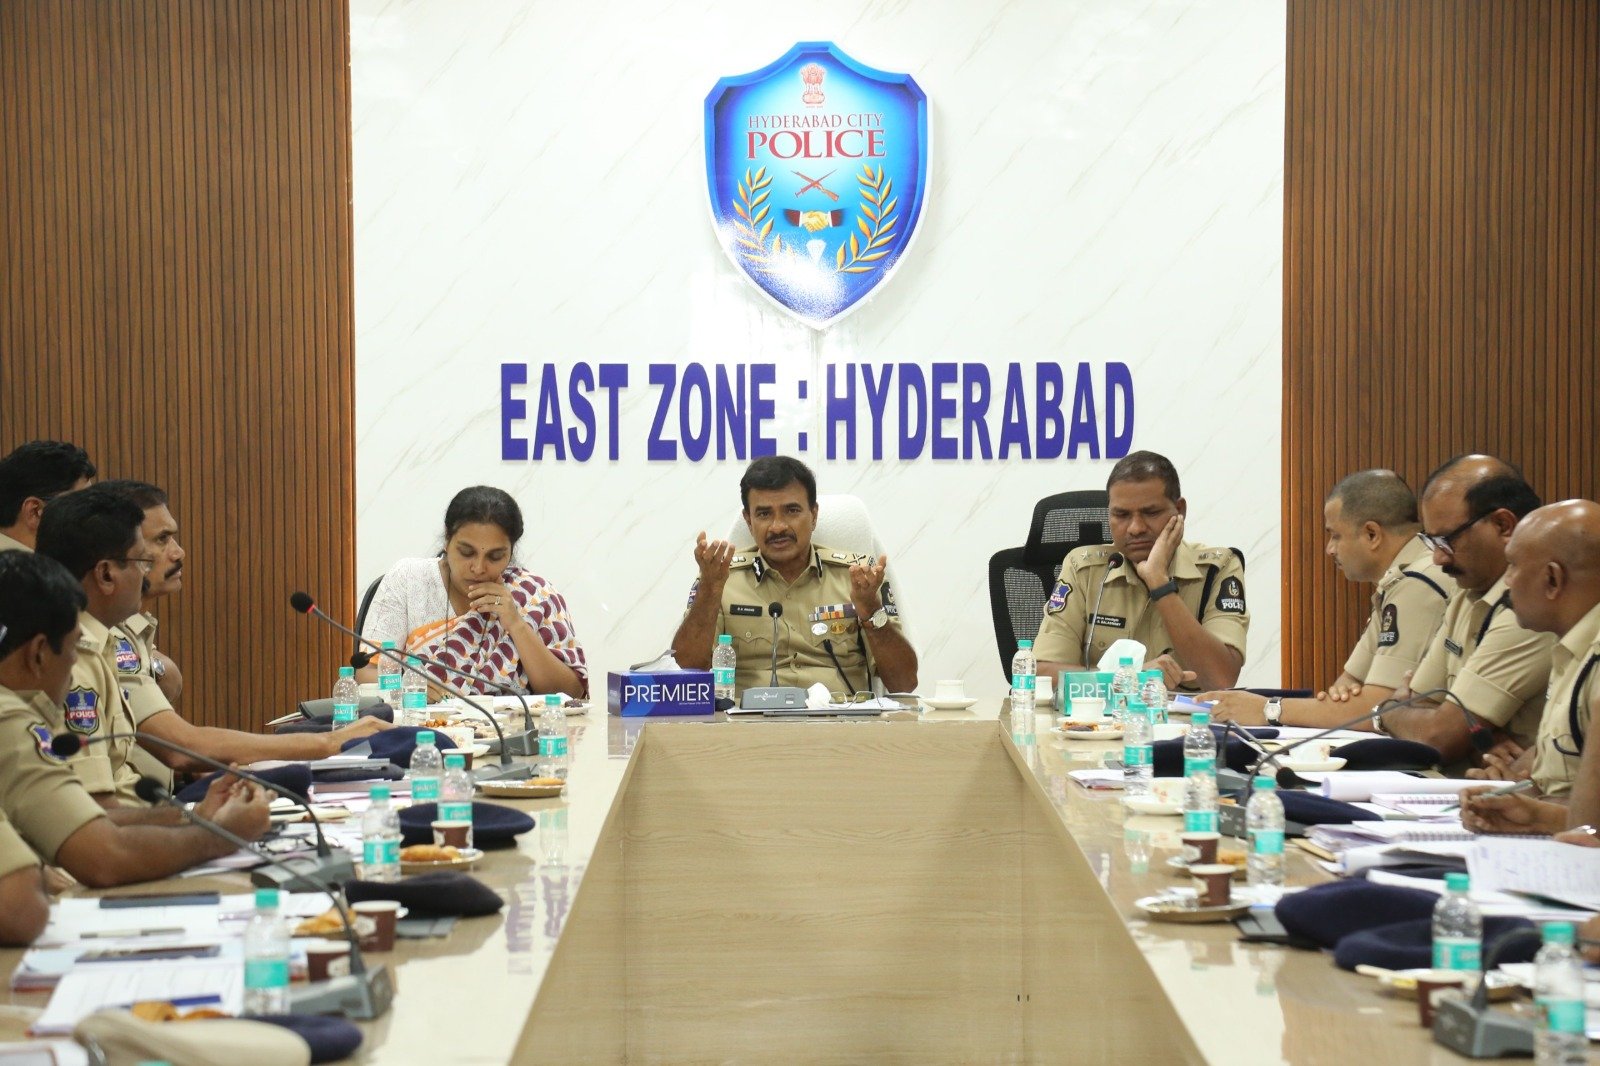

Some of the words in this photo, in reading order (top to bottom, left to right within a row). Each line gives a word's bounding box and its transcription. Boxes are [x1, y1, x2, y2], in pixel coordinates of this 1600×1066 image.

[749, 114, 842, 129] HYDERABAD
[847, 113, 883, 127] CITY
[747, 129, 886, 159] POLICE
[501, 361, 629, 462] EAST
[647, 362, 777, 462] ZONE
[826, 361, 1135, 461] HYDERABAD
[624, 683, 710, 703] PREMIER
[69, 710, 97, 719] POLICE
